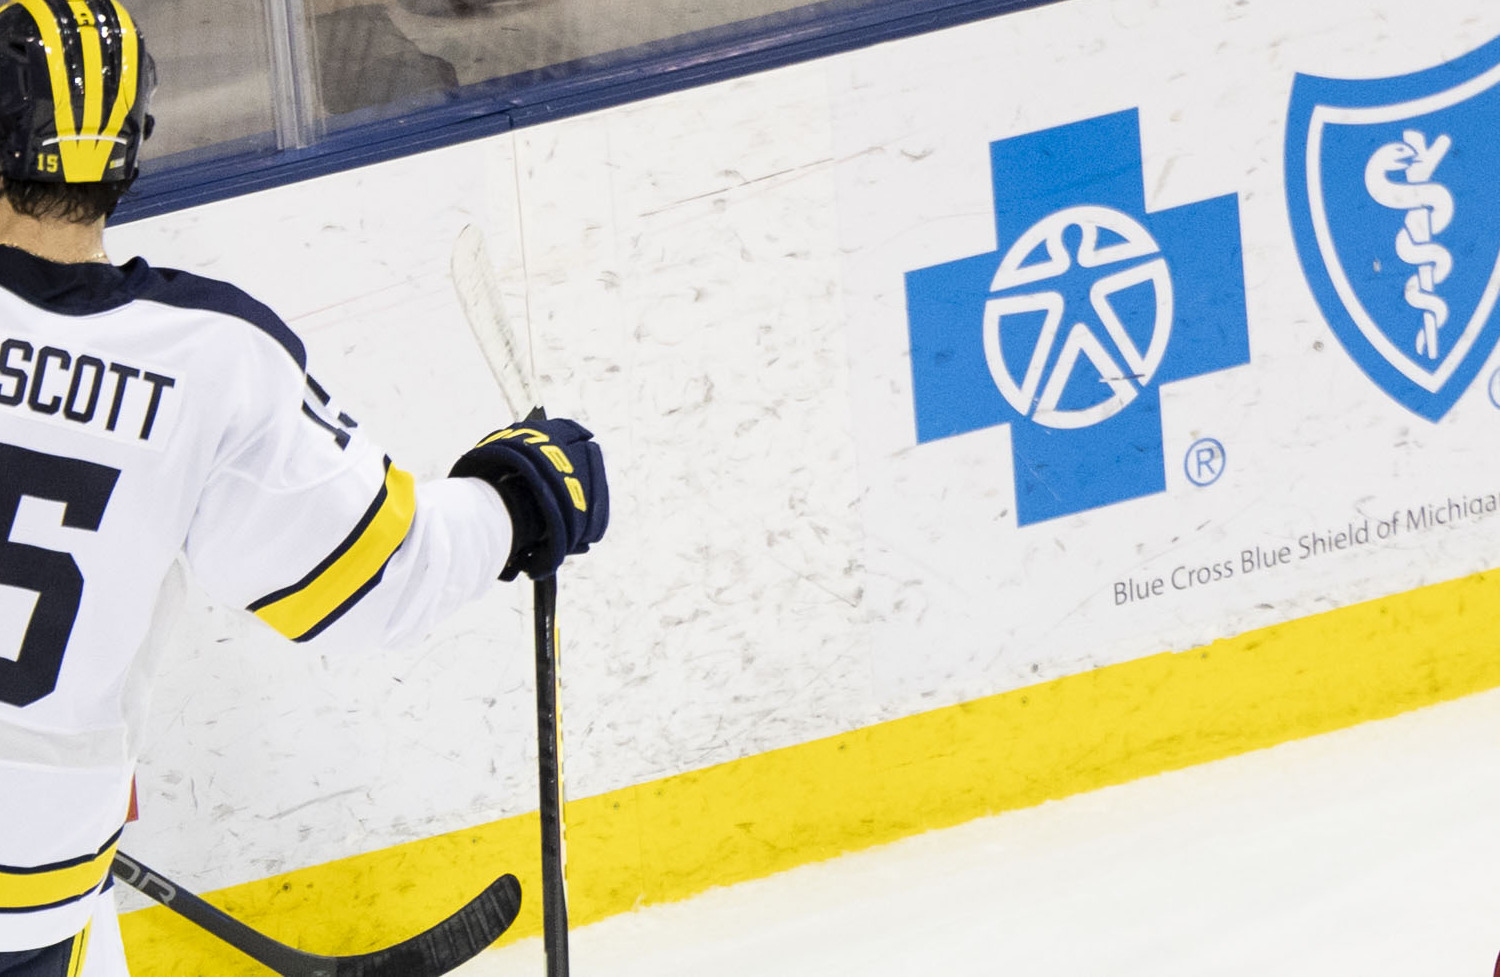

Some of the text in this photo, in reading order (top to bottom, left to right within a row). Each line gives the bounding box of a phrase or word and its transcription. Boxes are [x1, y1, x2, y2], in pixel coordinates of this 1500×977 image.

[37, 153, 59, 173] 15
[1113, 493, 1500, 606] Blue Cross Blue Shield of Michiga
